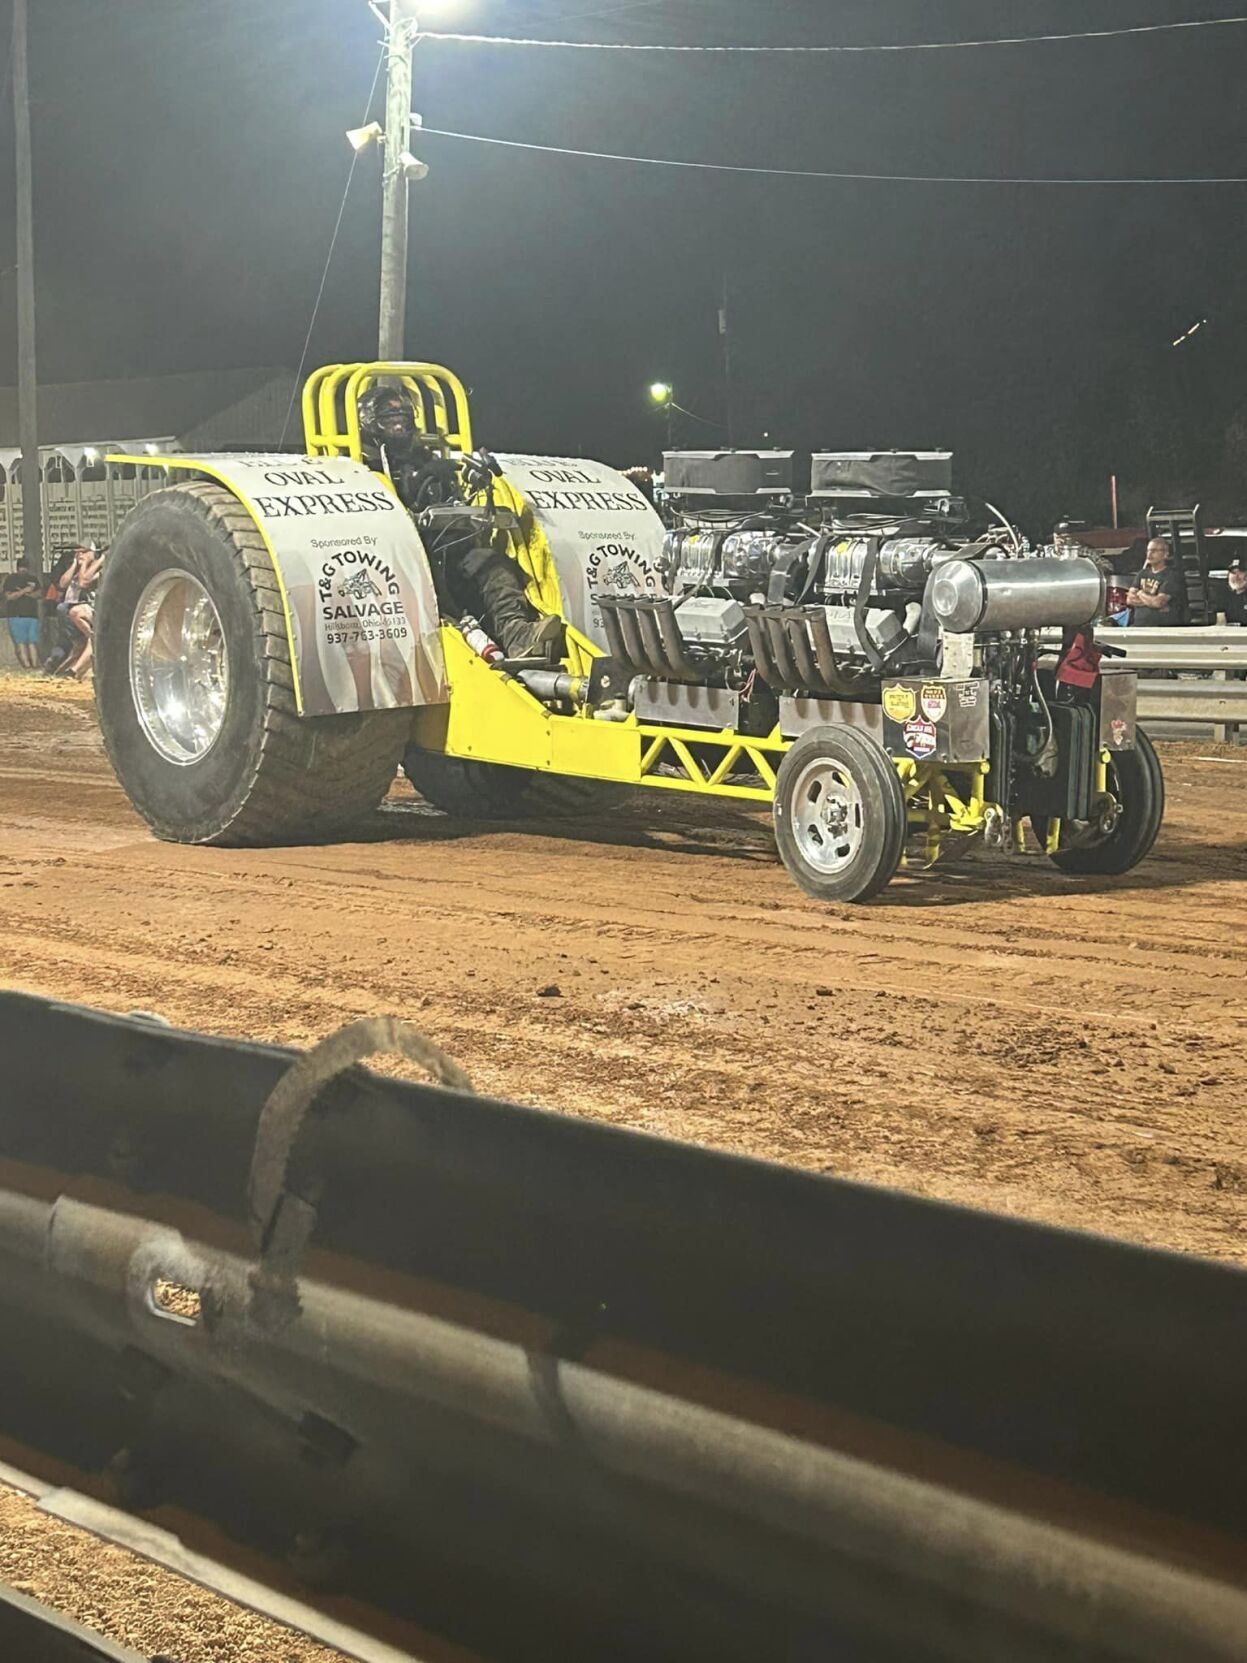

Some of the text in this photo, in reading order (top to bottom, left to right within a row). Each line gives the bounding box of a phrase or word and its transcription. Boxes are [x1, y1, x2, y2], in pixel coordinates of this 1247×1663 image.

[264, 470, 345, 487] OVAL
[529, 469, 602, 484] OVAL
[253, 491, 395, 518] EXPRESS
[525, 490, 648, 511] EXPRESS
[311, 535, 378, 549] Sponsored By
[586, 544, 656, 589] T&G TOWING
[318, 550, 400, 603] T&G TOWING
[322, 601, 405, 620] SALVAGE
[327, 627, 408, 645] 937-763-3609
